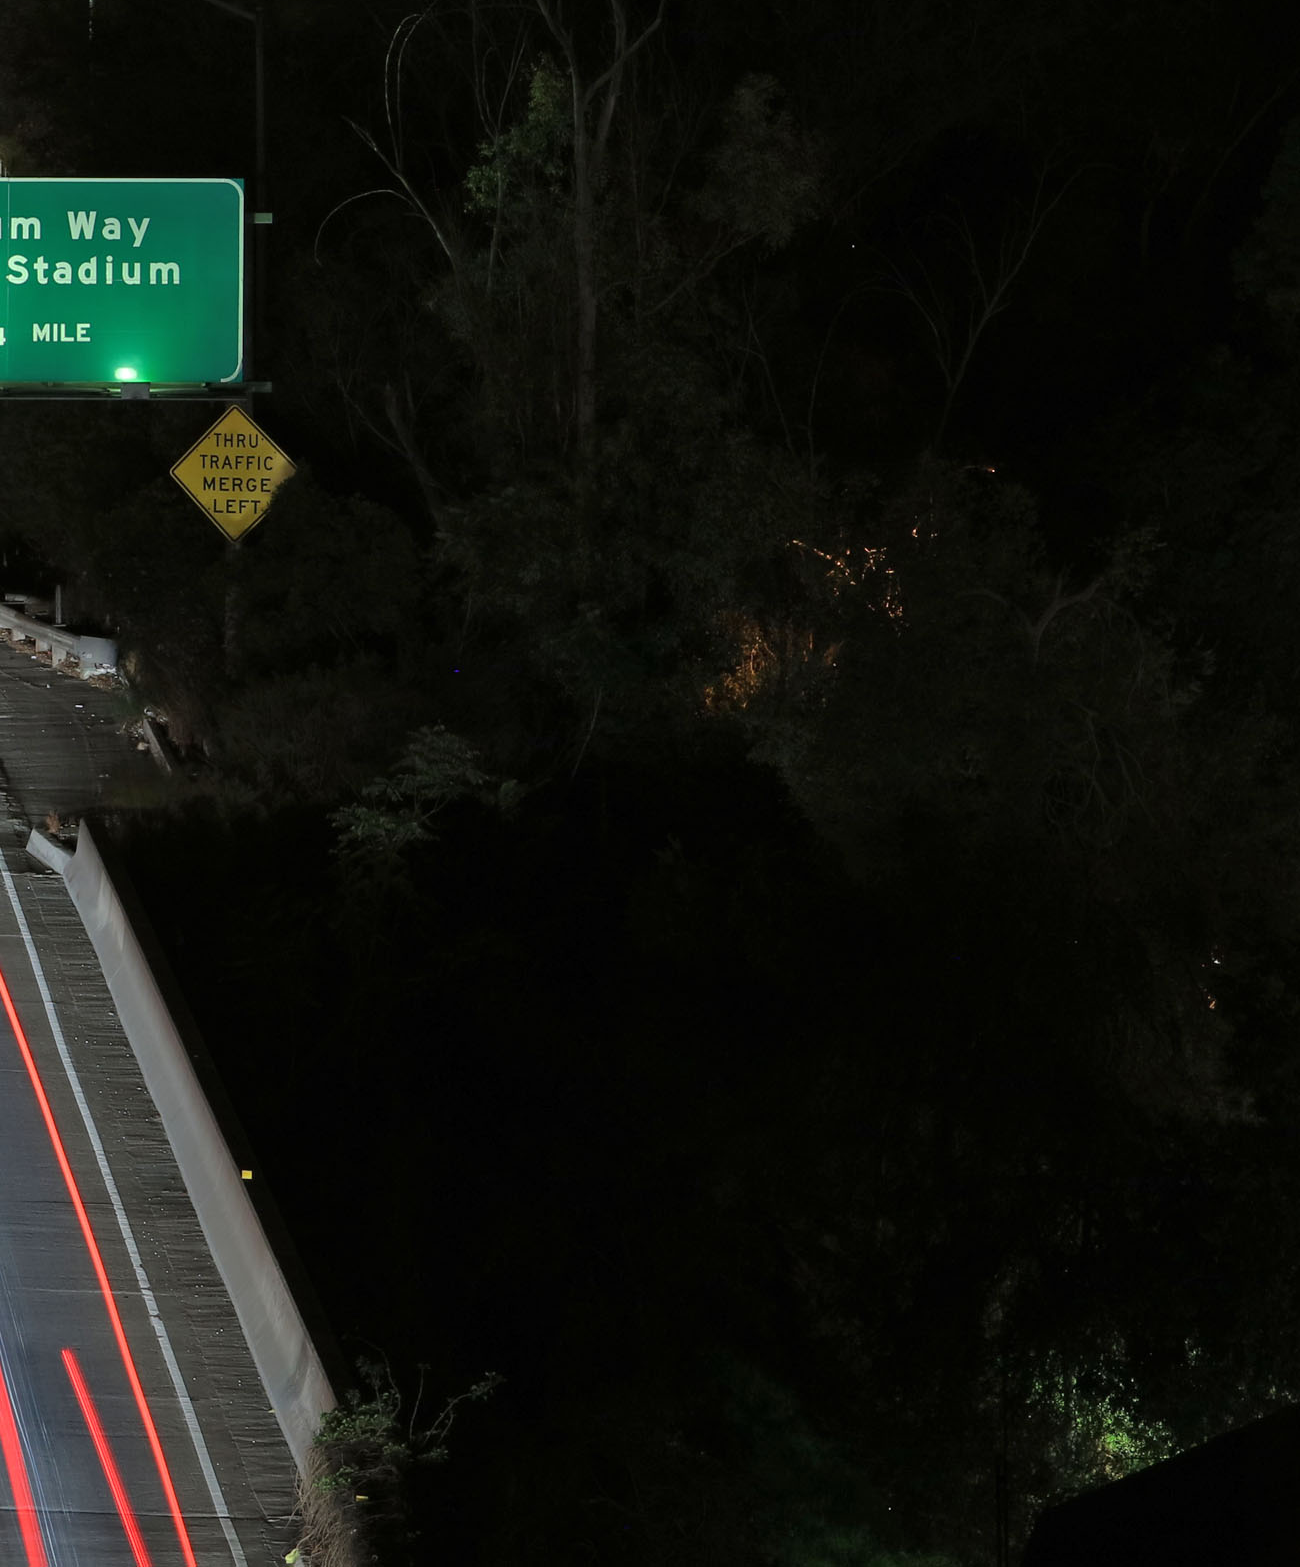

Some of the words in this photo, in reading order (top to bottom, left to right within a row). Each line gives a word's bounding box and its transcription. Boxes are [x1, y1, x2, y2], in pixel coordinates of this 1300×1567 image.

[67, 211, 151, 247] Way
[6, 255, 181, 285] Stadium
[32, 323, 91, 342] MILE
[214, 433, 259, 448] THRU
[200, 454, 273, 471] TRAFFIC
[203, 477, 271, 492] MERGE
[213, 499, 261, 514] LEFT
